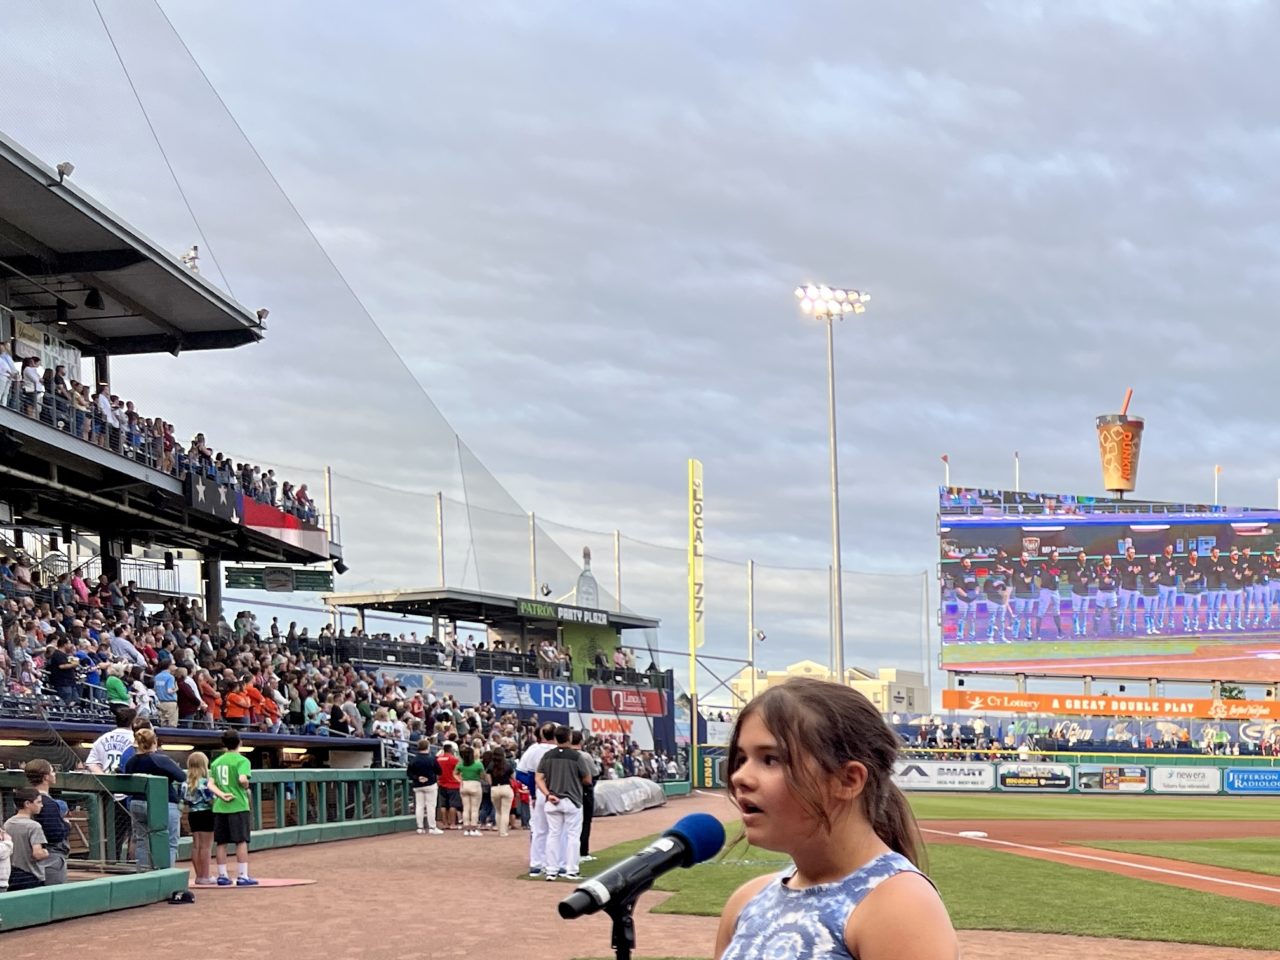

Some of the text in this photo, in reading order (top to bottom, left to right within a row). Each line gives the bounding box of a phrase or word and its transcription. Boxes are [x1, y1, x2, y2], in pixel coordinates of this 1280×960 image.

[692, 488, 704, 557] LOCAL
[693, 583, 704, 623] 777
[558, 607, 582, 621] PARTY
[584, 610, 608, 625] PLAZA
[541, 683, 576, 708] HSB
[1003, 696, 1040, 711] Lottery
[1052, 698, 1195, 713] A GREAT DOUBLE PLAY
[216, 765, 229, 786] 19
[704, 757, 712, 788] 325
[937, 767, 985, 777] SMART
[1229, 772, 1279, 782] JEFFERSON
